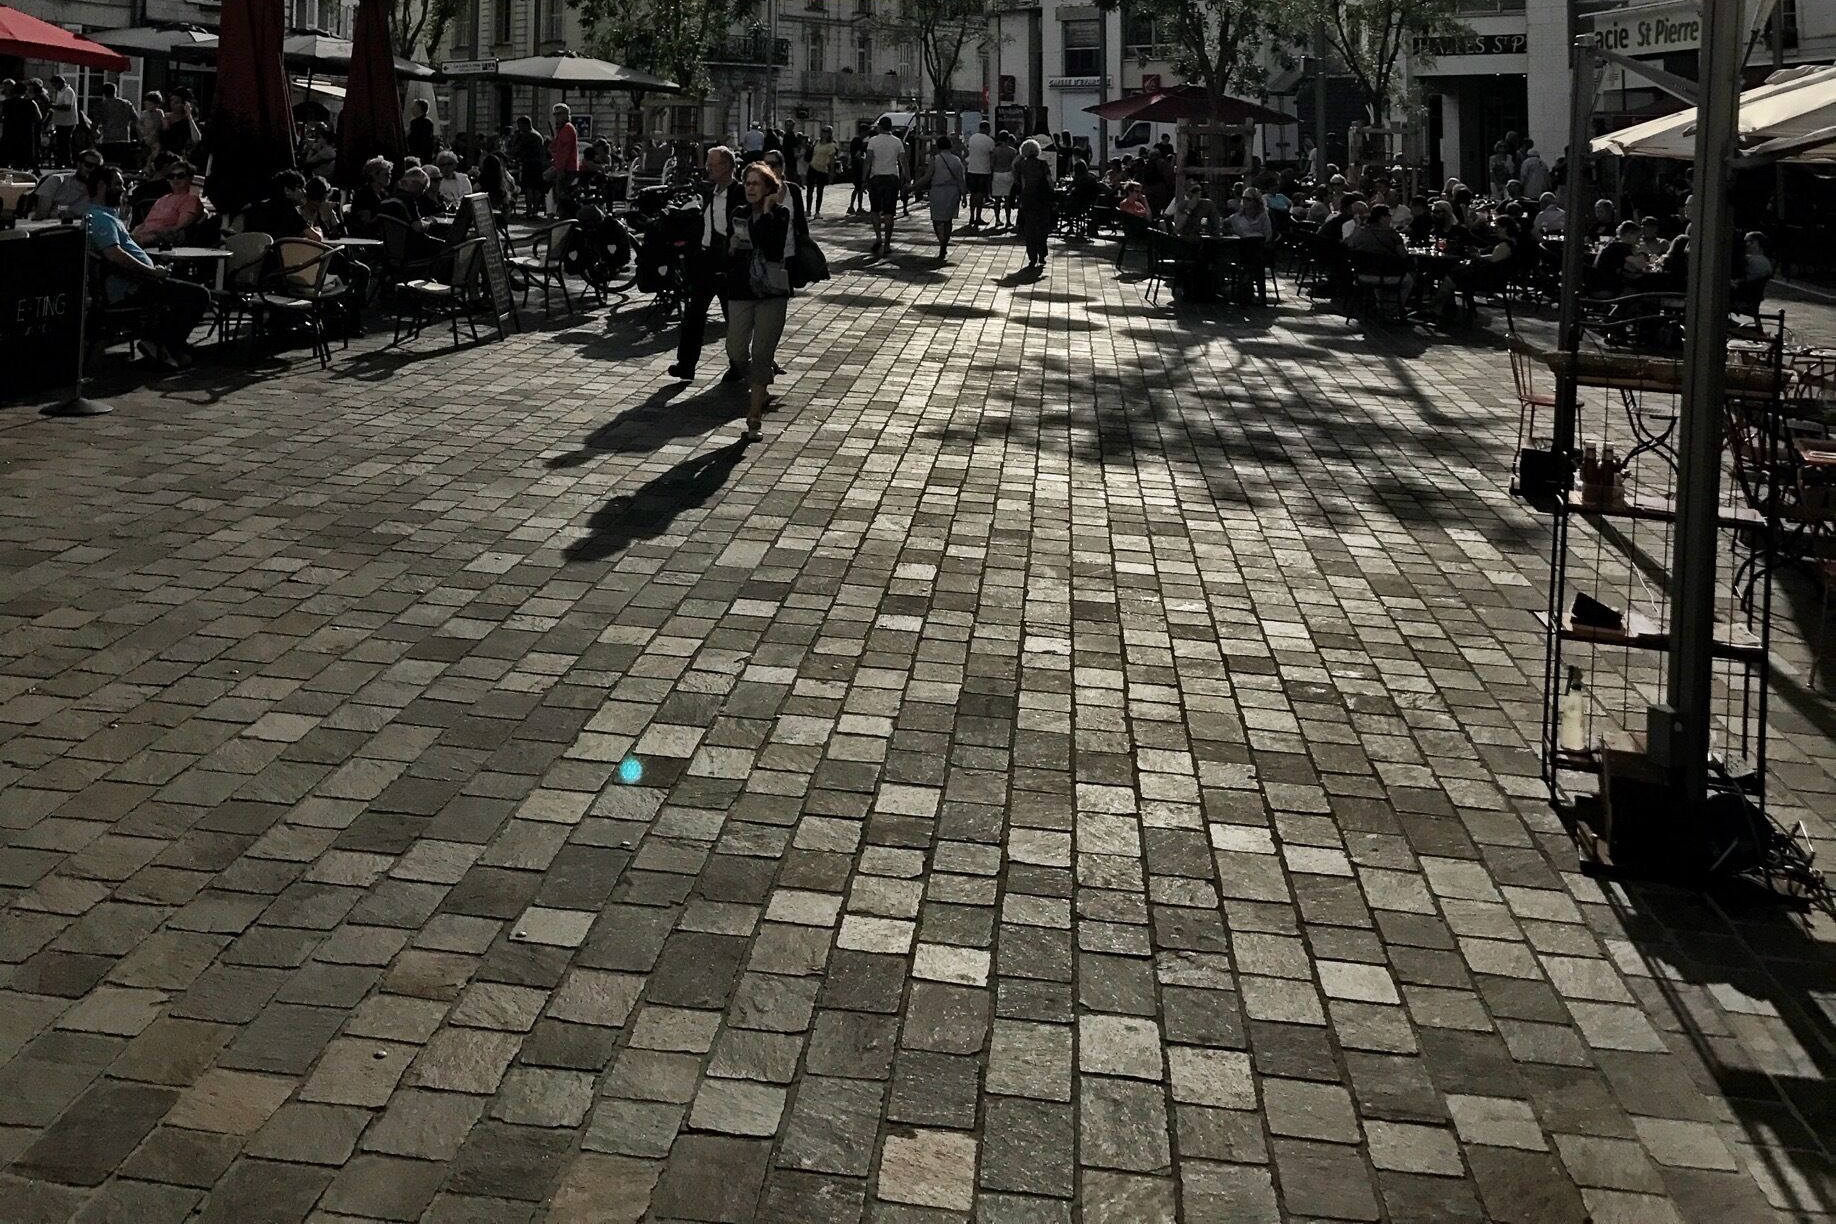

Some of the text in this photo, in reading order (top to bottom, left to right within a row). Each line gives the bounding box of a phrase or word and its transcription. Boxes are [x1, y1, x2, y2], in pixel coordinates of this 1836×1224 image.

[1637, 21, 1652, 47] St
[1655, 18, 1699, 45] Pierre
[16, 292, 67, 322] ETING
